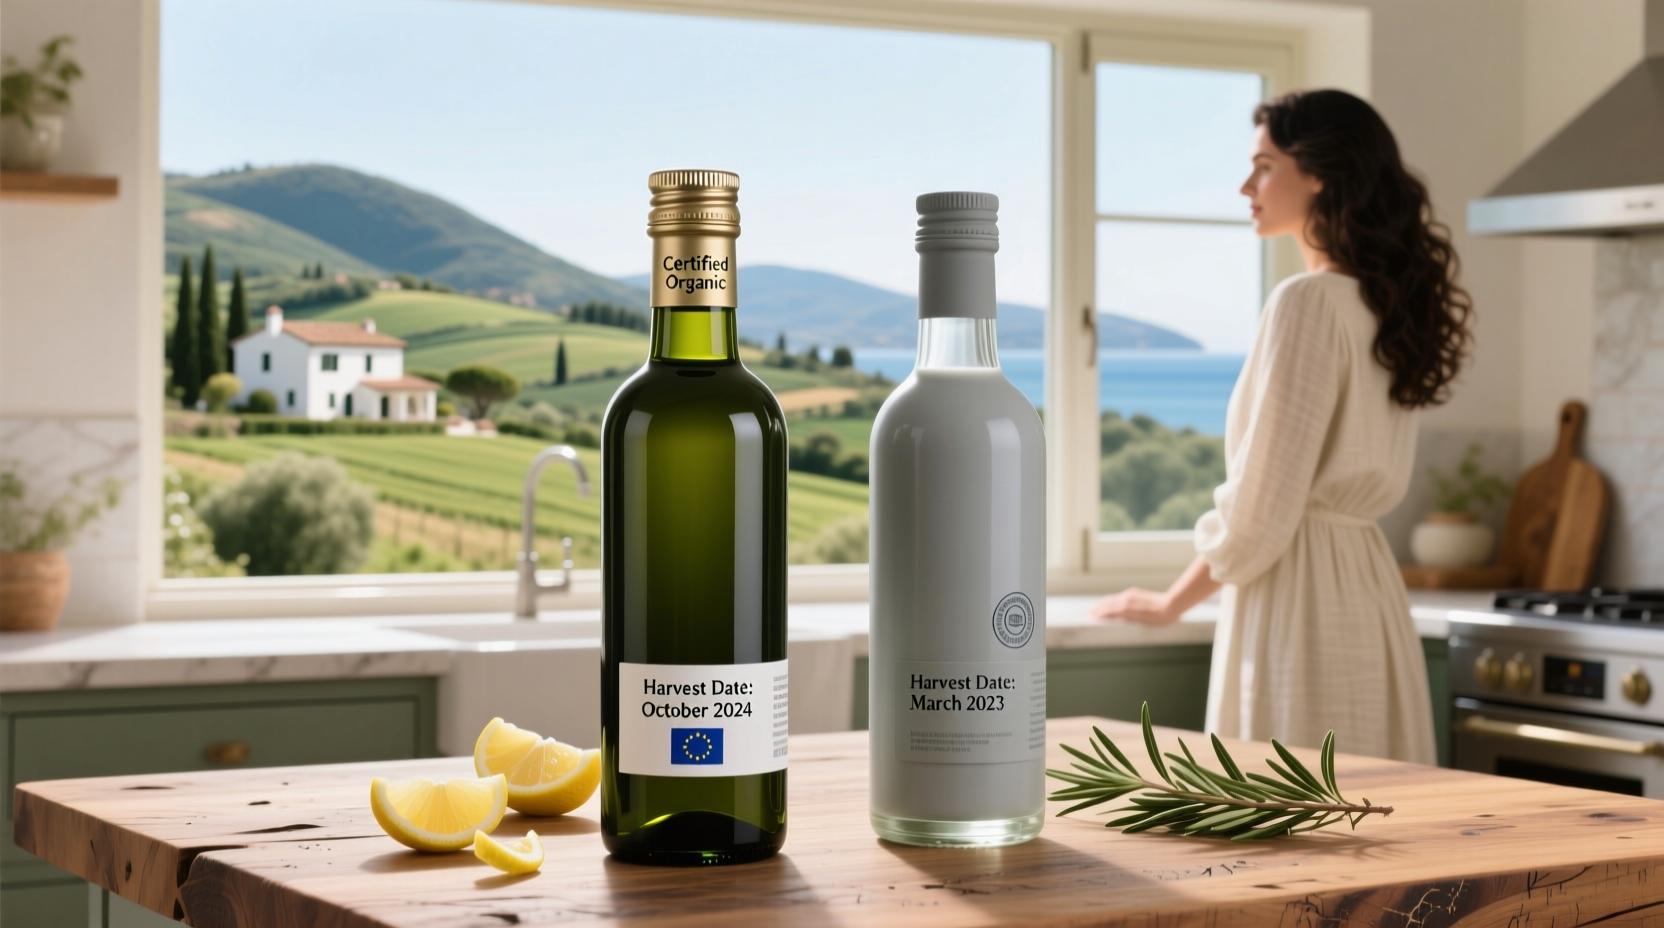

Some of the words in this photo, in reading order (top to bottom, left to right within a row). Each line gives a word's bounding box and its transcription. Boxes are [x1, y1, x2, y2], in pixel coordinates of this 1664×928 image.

[663, 254, 729, 272] Certified
[665, 274, 727, 294] Organic
[643, 678, 706, 696] Harvest
[711, 679, 753, 696] Date:
[910, 673, 971, 690] Harvest
[976, 674, 1016, 690] Date:
[641, 701, 709, 718] October
[713, 702, 753, 718] 2024
[909, 694, 962, 711] March
[966, 695, 1005, 711] 2023
